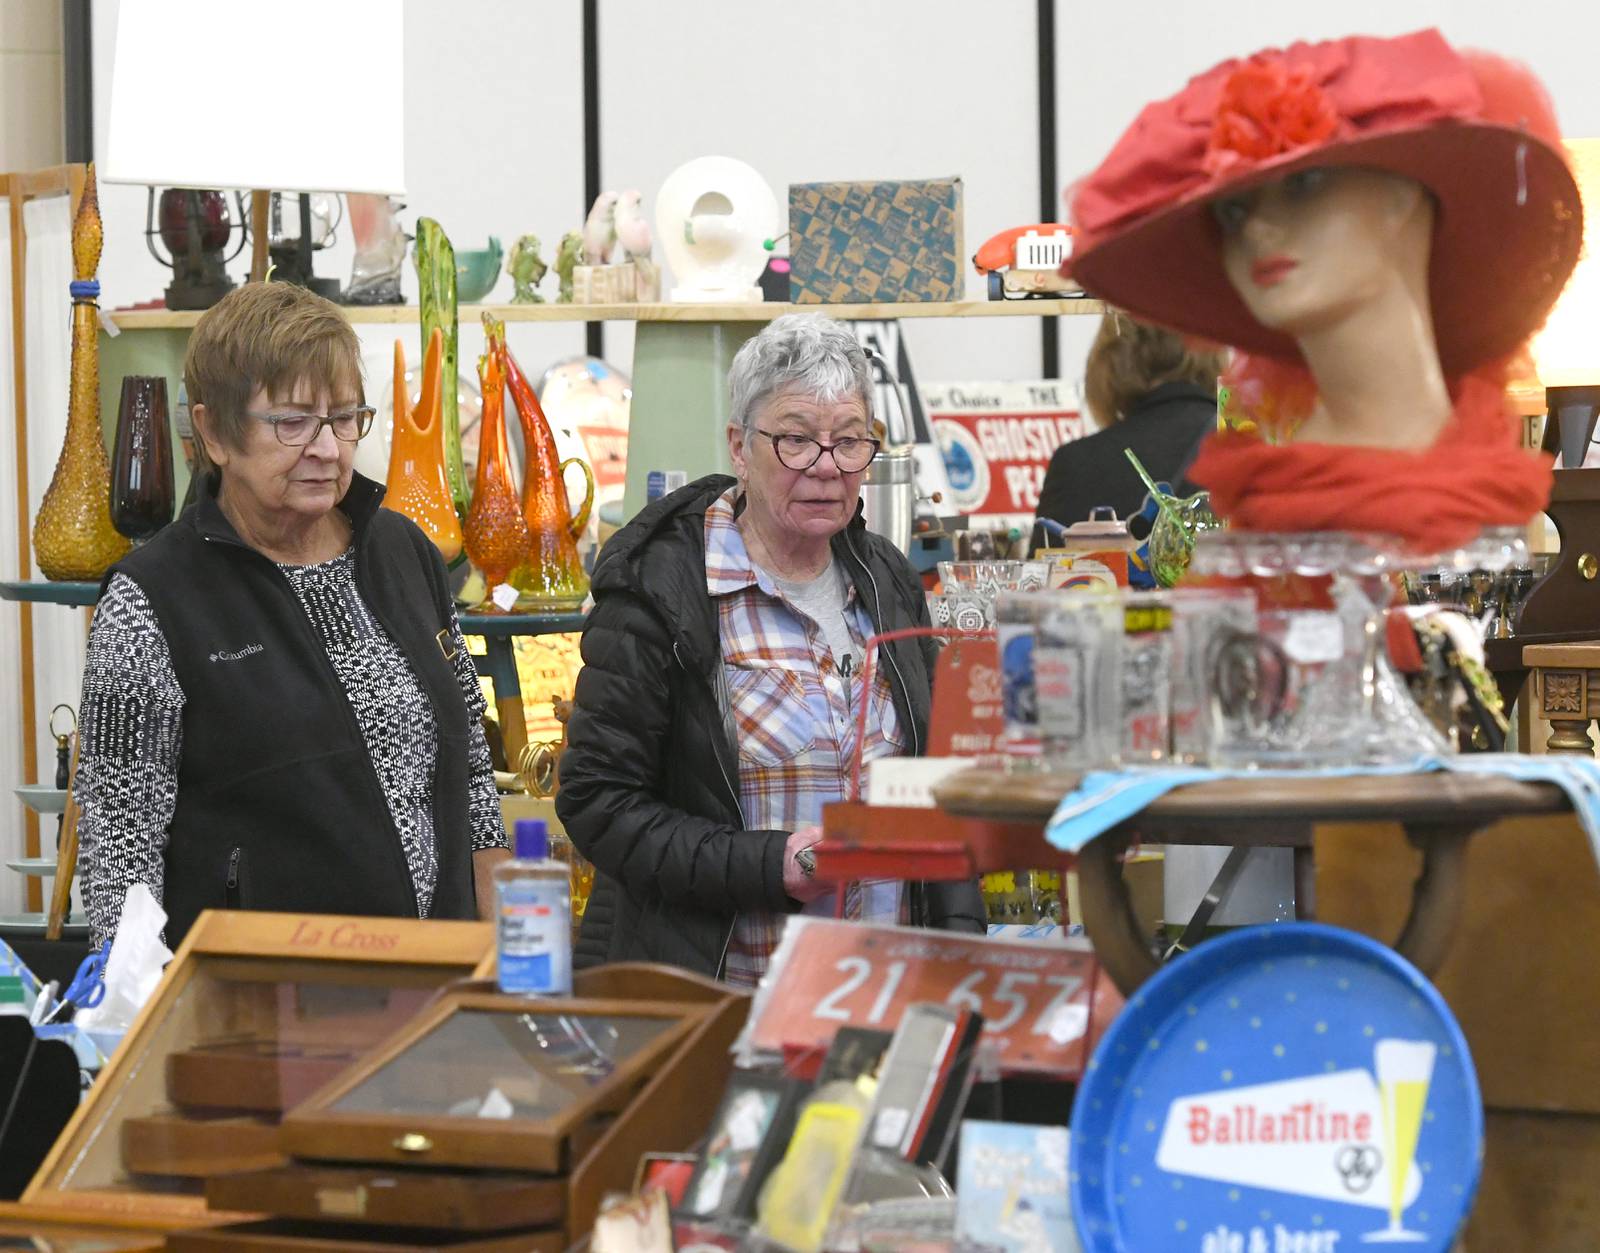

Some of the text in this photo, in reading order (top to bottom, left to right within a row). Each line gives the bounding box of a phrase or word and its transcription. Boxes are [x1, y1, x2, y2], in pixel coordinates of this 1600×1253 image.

[949, 388, 1001, 409] Choice
[1028, 386, 1060, 406] THE
[289, 920, 323, 946] La
[813, 955, 907, 1025] 21
